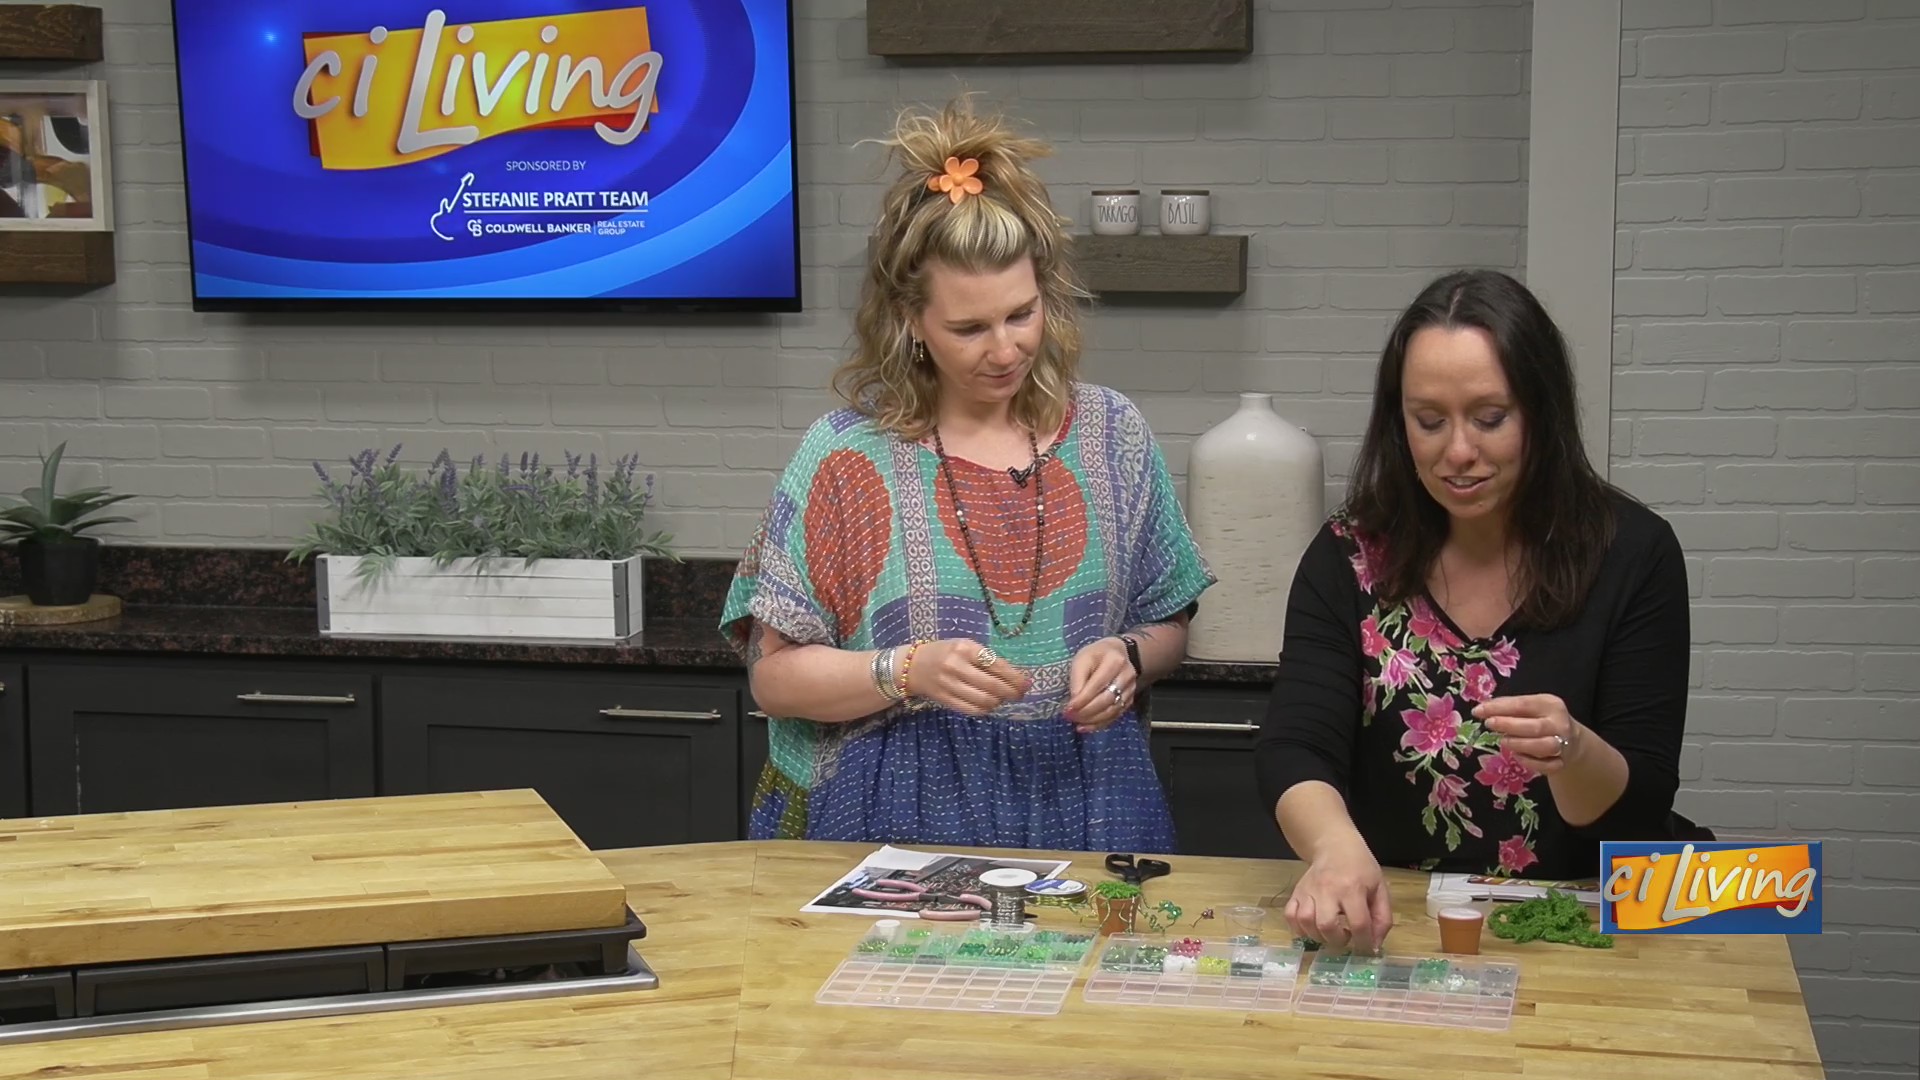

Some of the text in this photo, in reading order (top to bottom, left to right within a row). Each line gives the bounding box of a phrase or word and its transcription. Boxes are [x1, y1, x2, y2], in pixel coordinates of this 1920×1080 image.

[293, 9, 663, 154] ci Living
[506, 161, 586, 171] SPONSORED BY
[462, 191, 649, 208] STEFANIE PRATT TEAM
[1168, 203, 1198, 224] BASIL
[485, 223, 592, 233] COLDWELL BANKER
